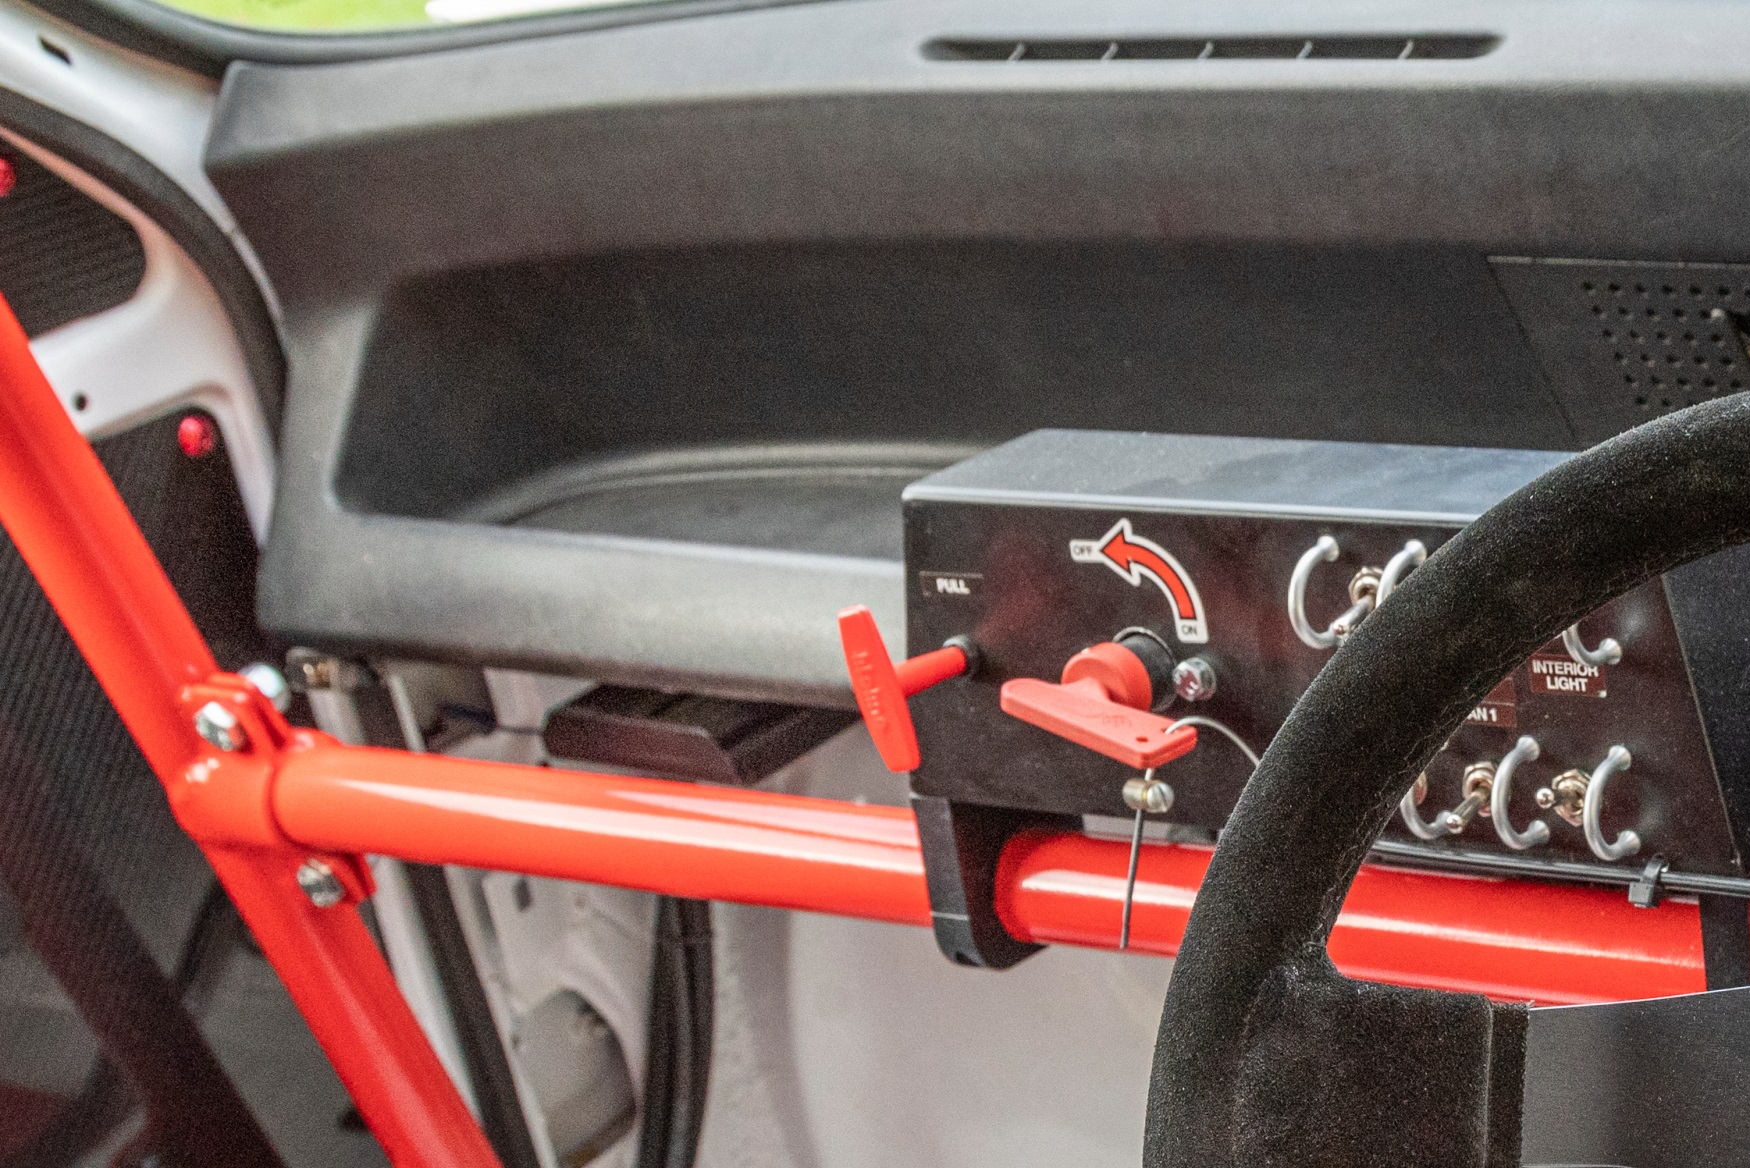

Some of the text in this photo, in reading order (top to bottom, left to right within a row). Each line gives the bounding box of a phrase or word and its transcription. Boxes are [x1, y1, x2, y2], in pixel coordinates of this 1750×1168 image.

[936, 577, 970, 594] PULL
[1181, 624, 1197, 636] ON
[1532, 660, 1600, 677] INTERIOR
[1546, 676, 1589, 692] LIGHT
